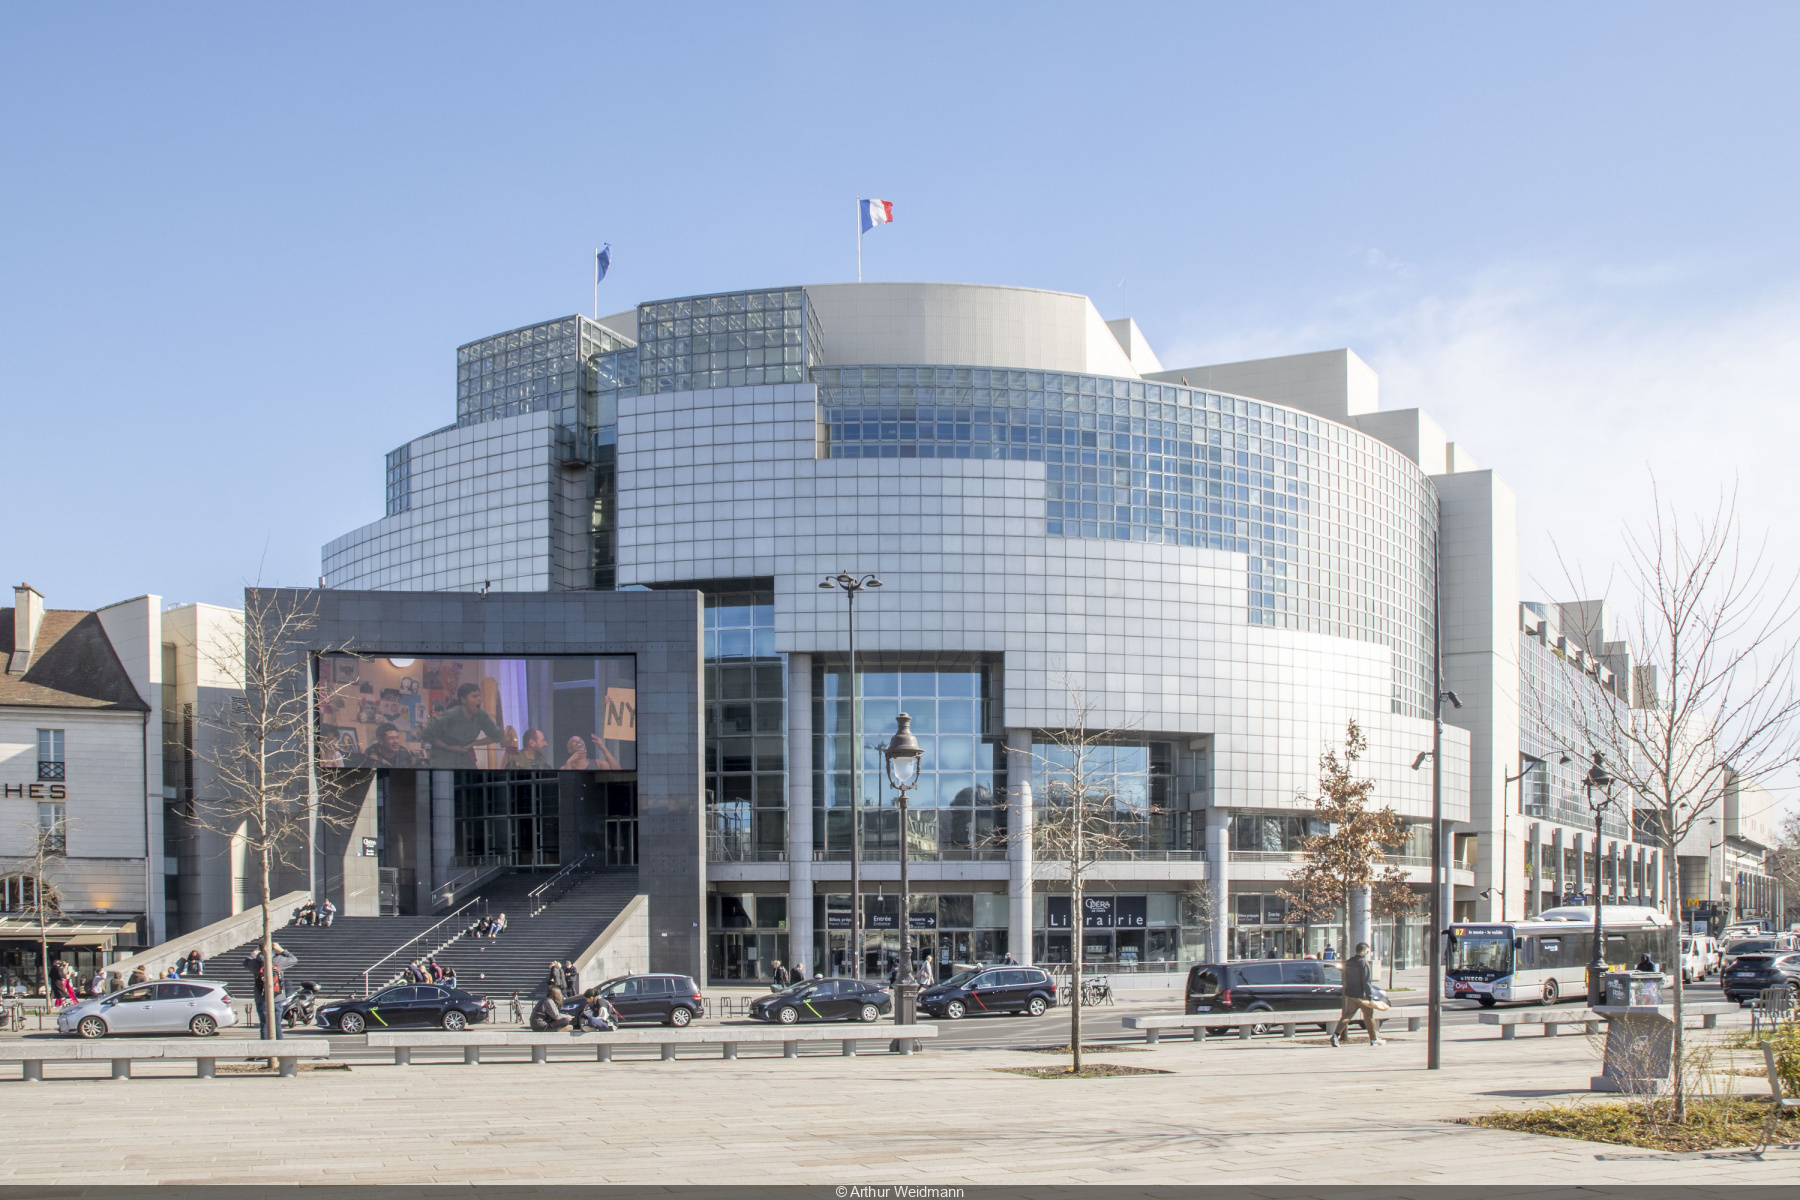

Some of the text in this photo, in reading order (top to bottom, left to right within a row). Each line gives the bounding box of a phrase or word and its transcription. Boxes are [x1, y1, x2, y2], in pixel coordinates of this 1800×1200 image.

[607, 700, 635, 728] NY
[5, 783, 66, 799] HES
[1687, 897, 1700, 908] M
[1051, 914, 1144, 926] Lirairie
[1455, 928, 1464, 936] 87
